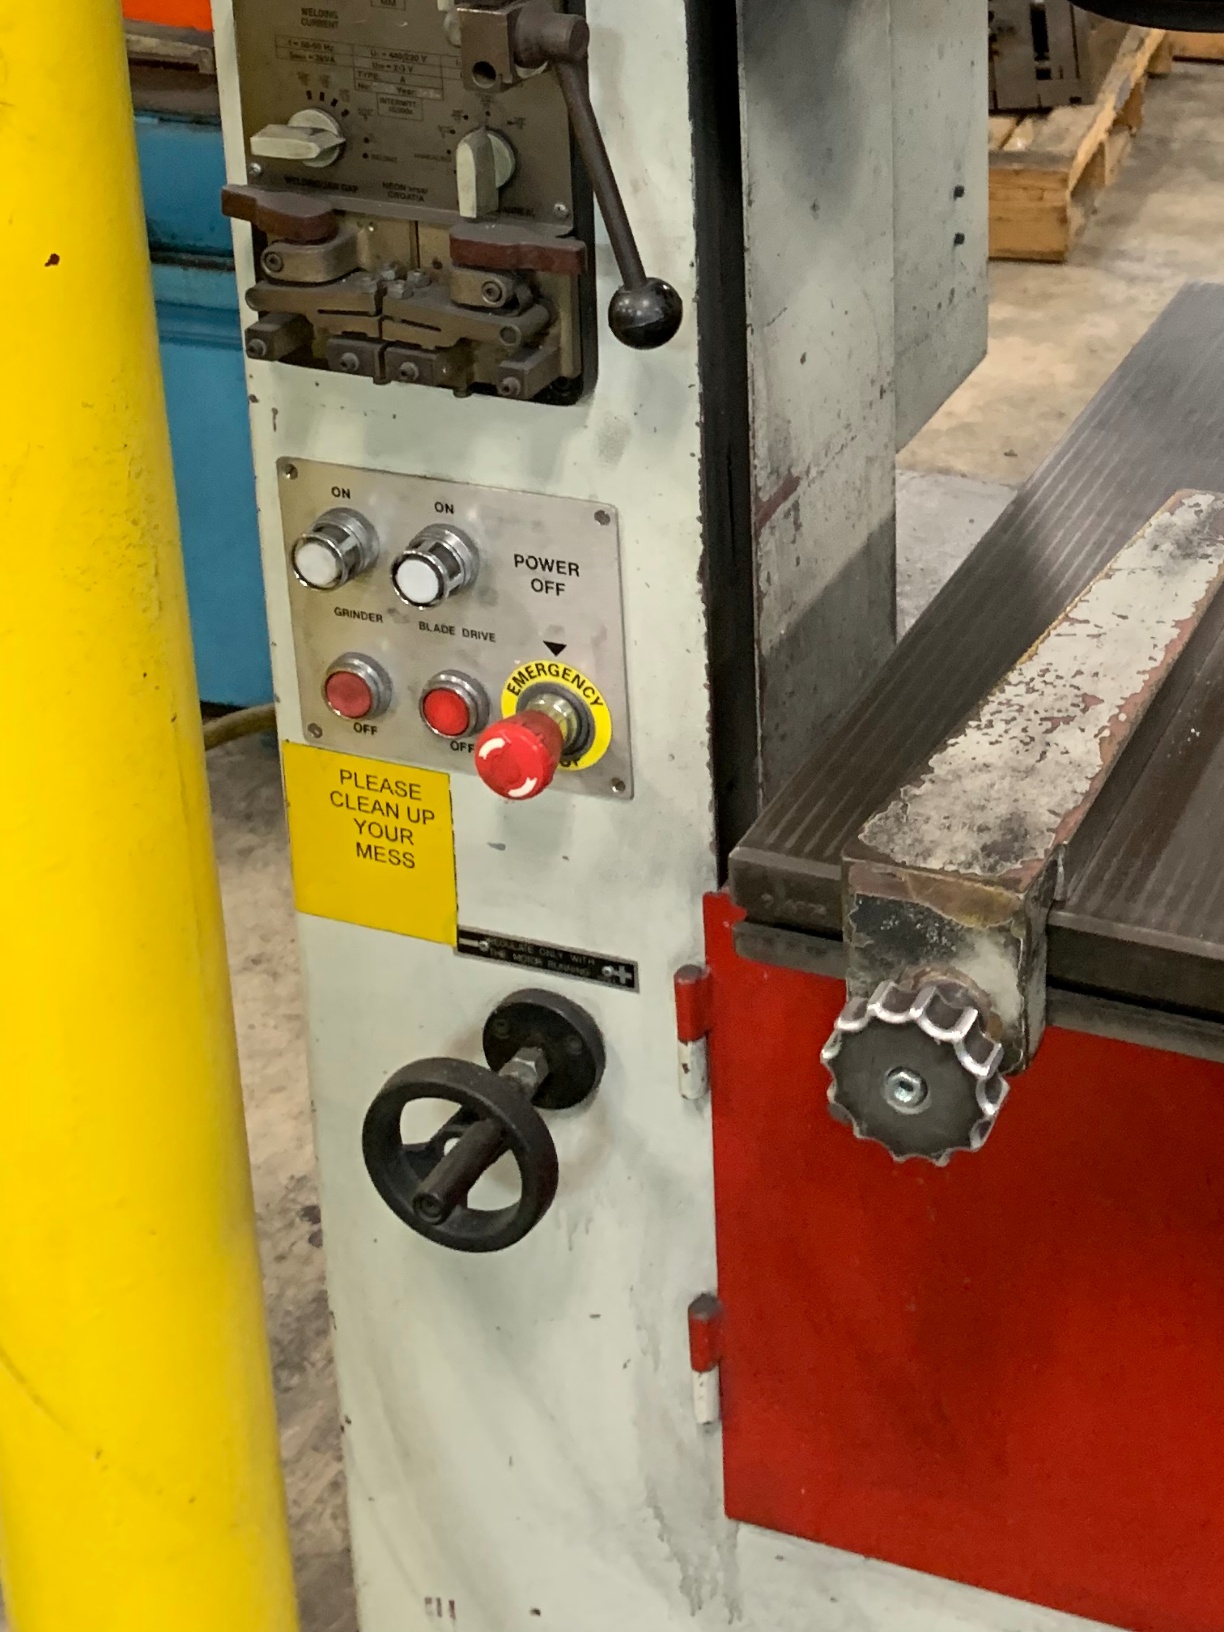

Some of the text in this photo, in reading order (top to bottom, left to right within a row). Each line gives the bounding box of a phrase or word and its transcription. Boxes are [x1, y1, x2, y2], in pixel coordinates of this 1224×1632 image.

[300, 18, 340, 29] CURRENT
[387, 190, 425, 202] CROATIA
[331, 486, 351, 500] ON
[434, 501, 455, 515] ON
[513, 553, 580, 577] POWER
[530, 578, 566, 597] OFF
[334, 606, 384, 624] GRINDER
[418, 620, 496, 643] BLADE DRIVE
[506, 662, 604, 707] EMERGENCY
[353, 721, 378, 736] OFF
[450, 740, 475, 754] OFF
[339, 769, 422, 801] PLEASE
[329, 790, 436, 826] CLEAN UP
[353, 818, 415, 846] YOUR
[355, 841, 416, 869] MESS
